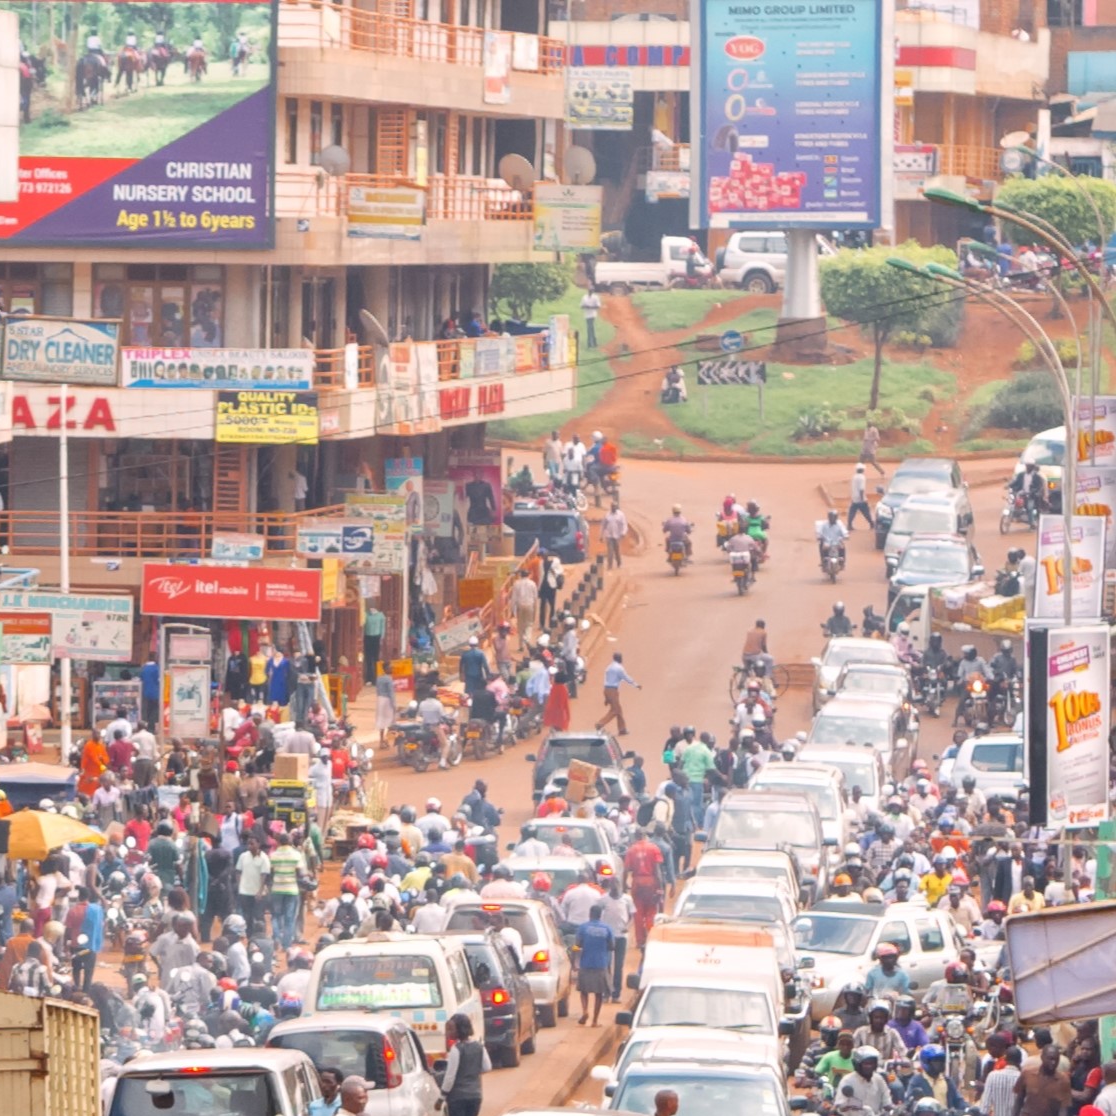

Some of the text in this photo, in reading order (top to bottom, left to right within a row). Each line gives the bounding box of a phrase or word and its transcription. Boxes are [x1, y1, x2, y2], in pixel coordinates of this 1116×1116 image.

[728, 4, 855, 15] MIMO GROUP LIMITED
[34, 168, 68, 179] Offices
[166, 162, 252, 180] CHRISTIAN
[113, 185, 255, 204] NURSERY SCHOOL
[117, 211, 148, 231] Age
[180, 212, 197, 228] to
[200, 211, 255, 232] 6years
[17, 326, 44, 337] STAR
[8, 339, 114, 365] DRY CLEANER
[123, 349, 191, 360] TRIPLEX
[229, 351, 266, 359] BEAUTY
[74, 366, 114, 376] SERVICES
[237, 391, 296, 402] QUALITY
[12, 395, 116, 431] AZA
[218, 402, 317, 416] PLASTIC IDs
[195, 579, 219, 595] itel
